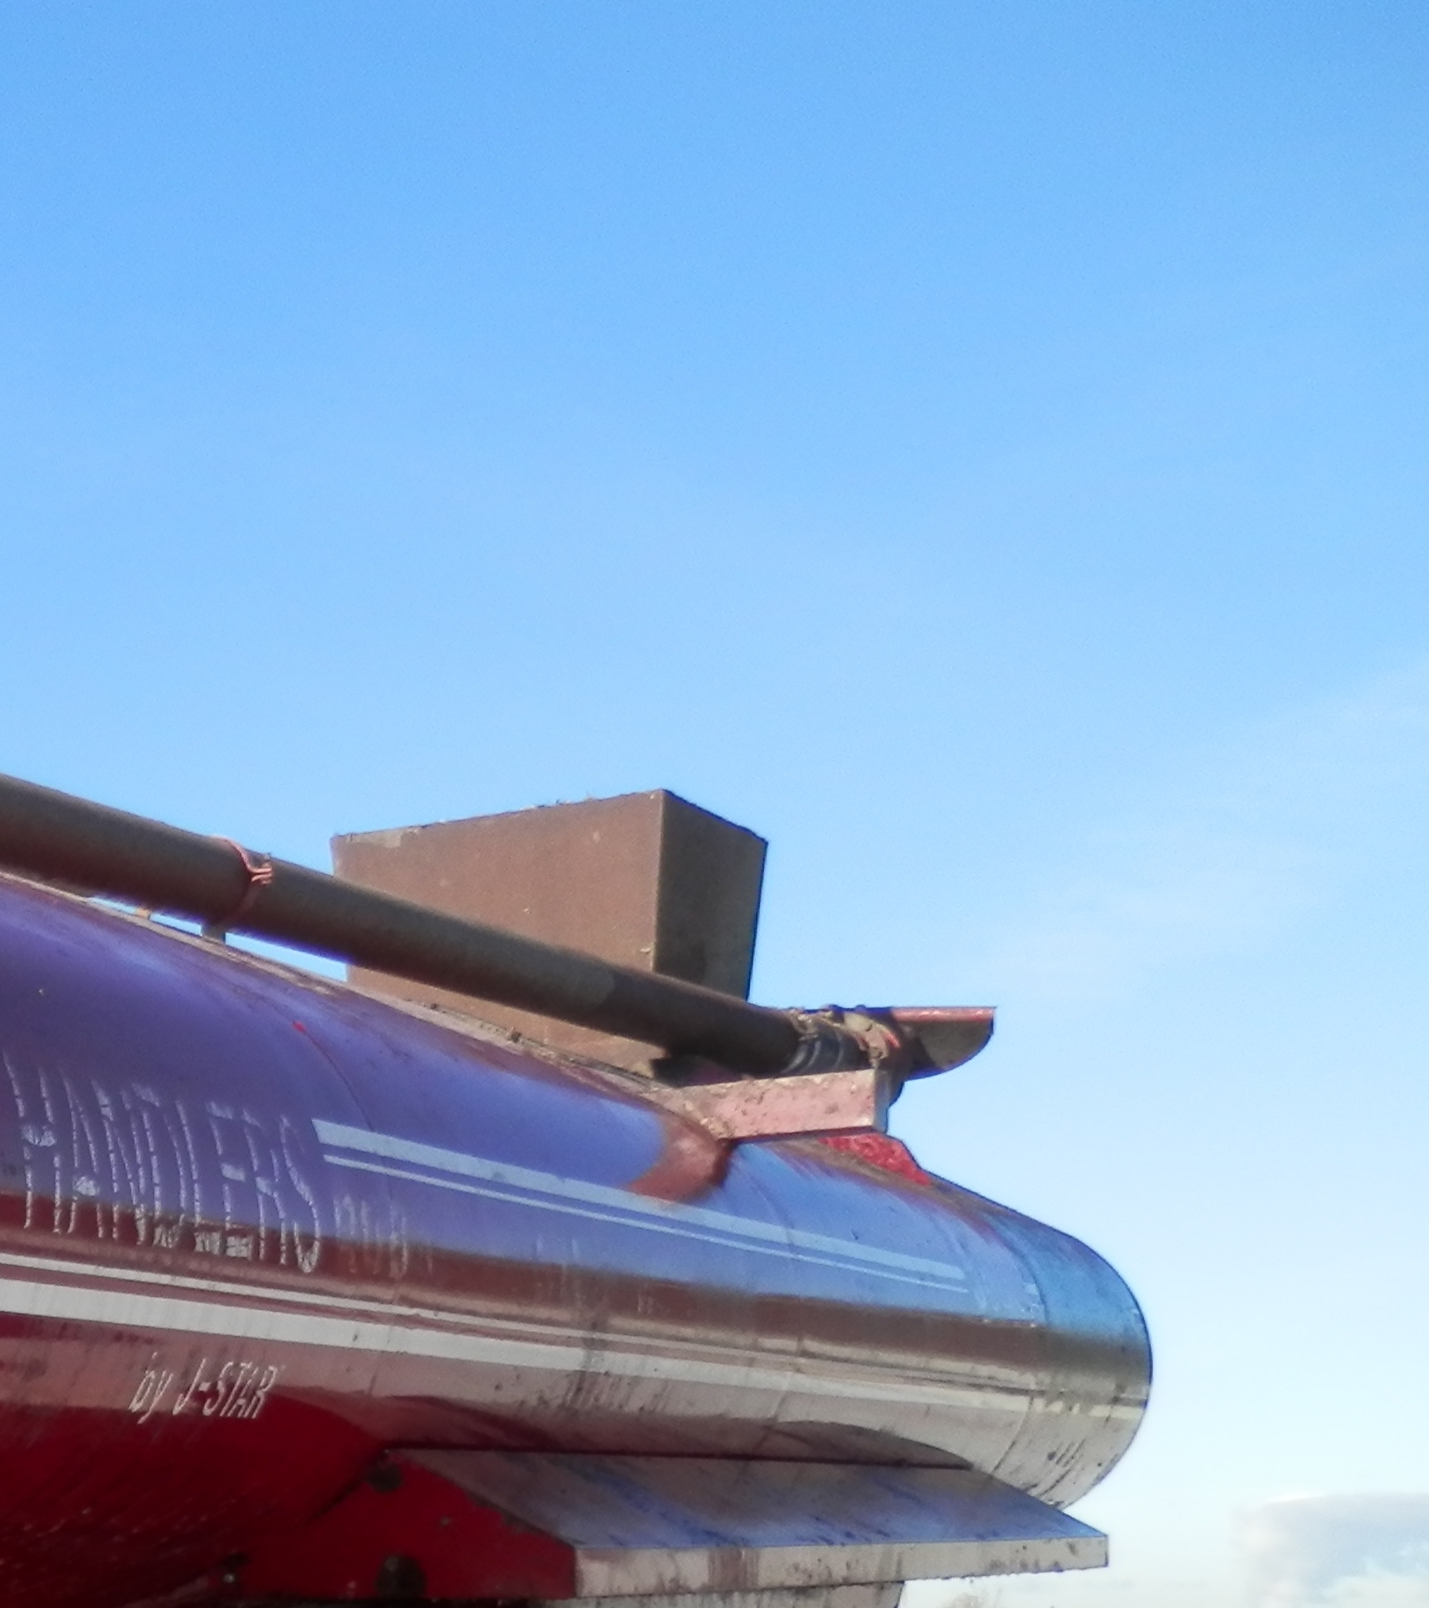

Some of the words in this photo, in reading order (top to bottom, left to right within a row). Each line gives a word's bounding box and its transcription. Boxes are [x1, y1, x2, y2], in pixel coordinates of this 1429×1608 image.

[2, 1050, 320, 1274] HANDLERS
[128, 1351, 174, 1425] by
[172, 1357, 278, 1420] J-STAR
